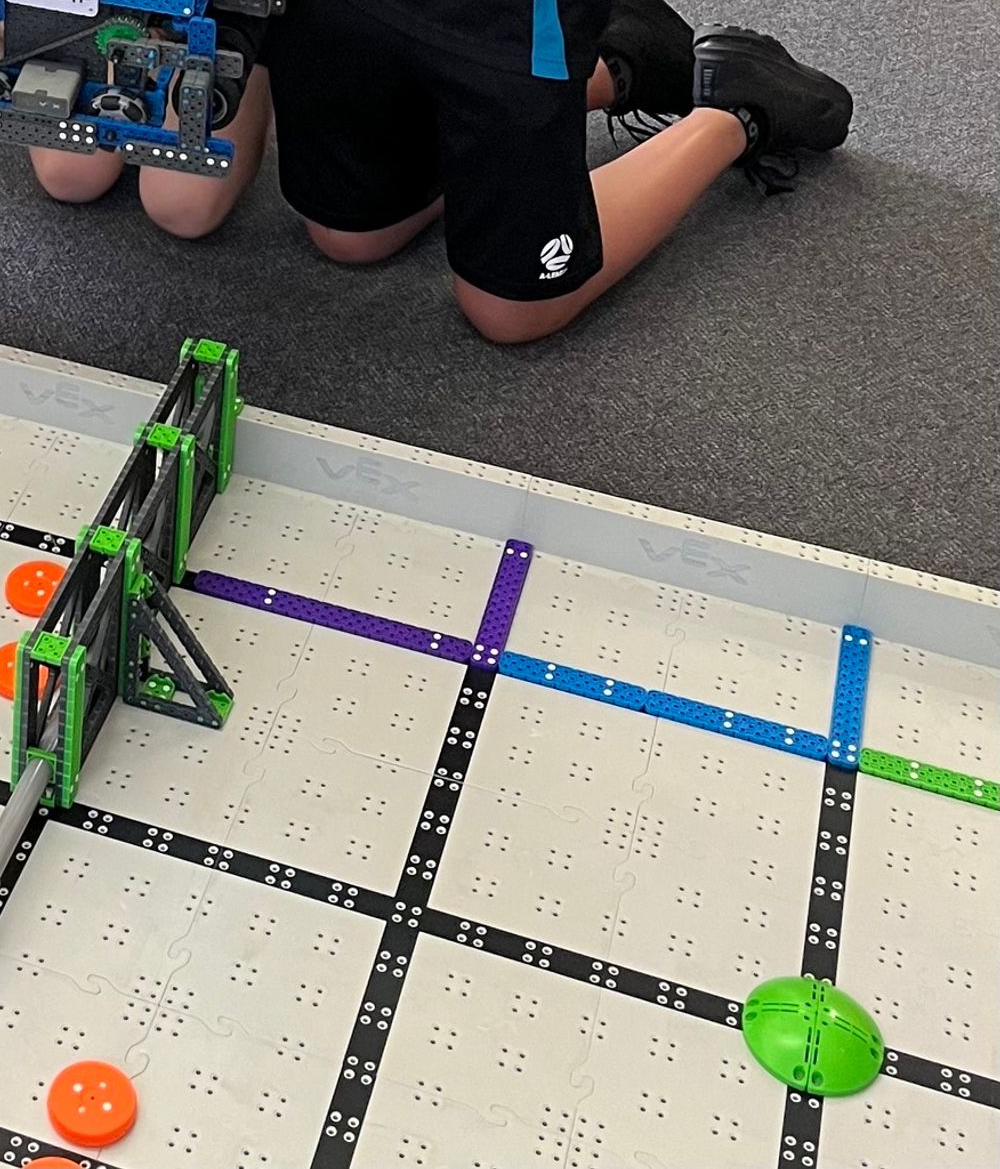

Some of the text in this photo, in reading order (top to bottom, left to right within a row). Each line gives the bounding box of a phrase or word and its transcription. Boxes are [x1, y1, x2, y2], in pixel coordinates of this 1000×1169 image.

[20, 380, 115, 426] VEX
[315, 456, 422, 502] VEX
[637, 535, 751, 585] VEX
